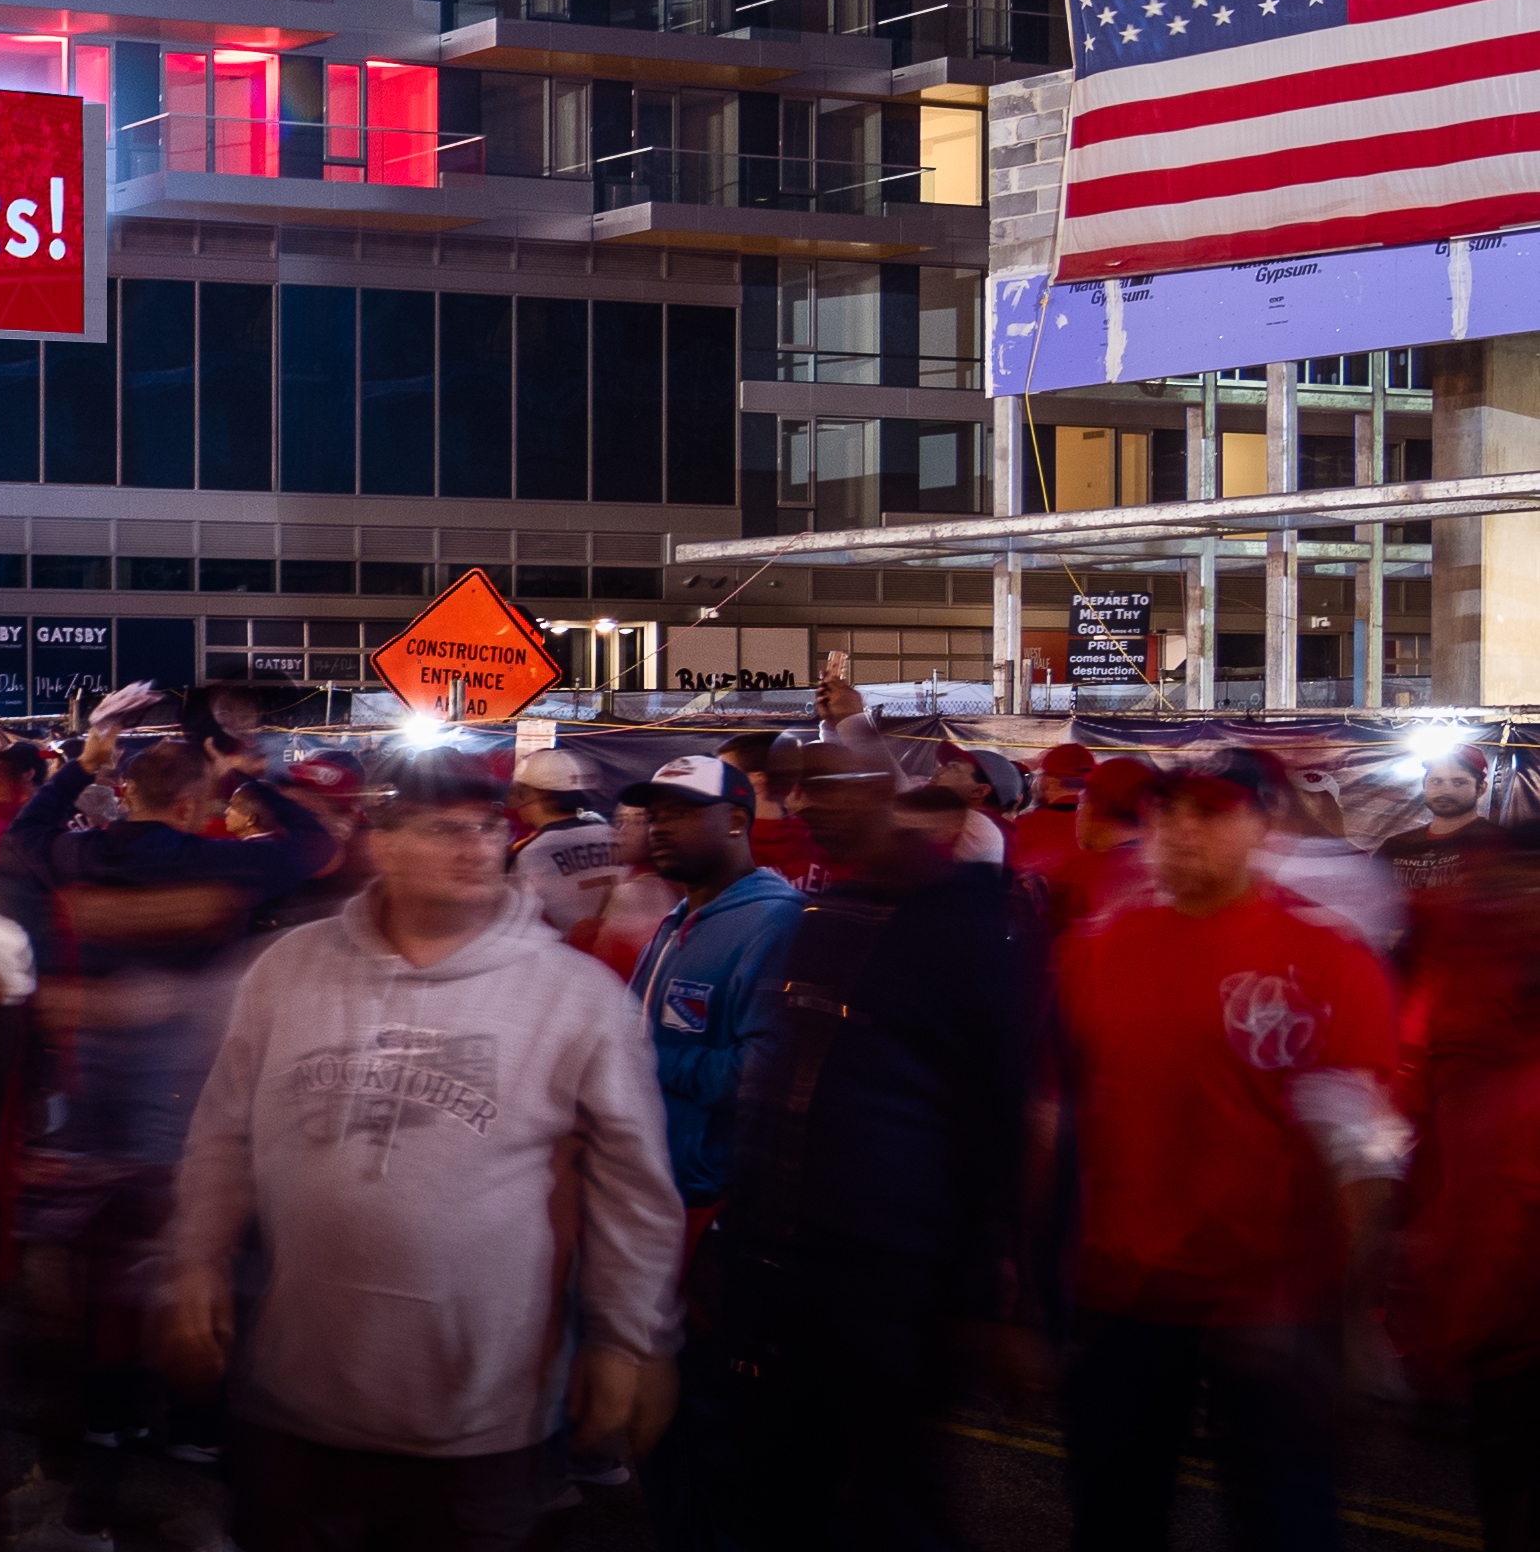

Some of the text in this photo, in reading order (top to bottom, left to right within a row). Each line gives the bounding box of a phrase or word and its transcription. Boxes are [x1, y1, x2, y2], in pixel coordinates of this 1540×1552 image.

[1255, 262, 1318, 285] Gypsum
[1069, 276, 1131, 294] Natioal
[1091, 287, 1150, 306] Gysum
[37, 627, 107, 643] GATSBY
[406, 638, 527, 665] CONSTRUCTION
[1087, 640, 1129, 651] PRIDE
[255, 659, 303, 670] GATSBY
[1069, 653, 1145, 663] comes before
[421, 667, 505, 690] ENTRANCE
[1072, 665, 1139, 676] destruction.
[435, 695, 488, 716] AAD
